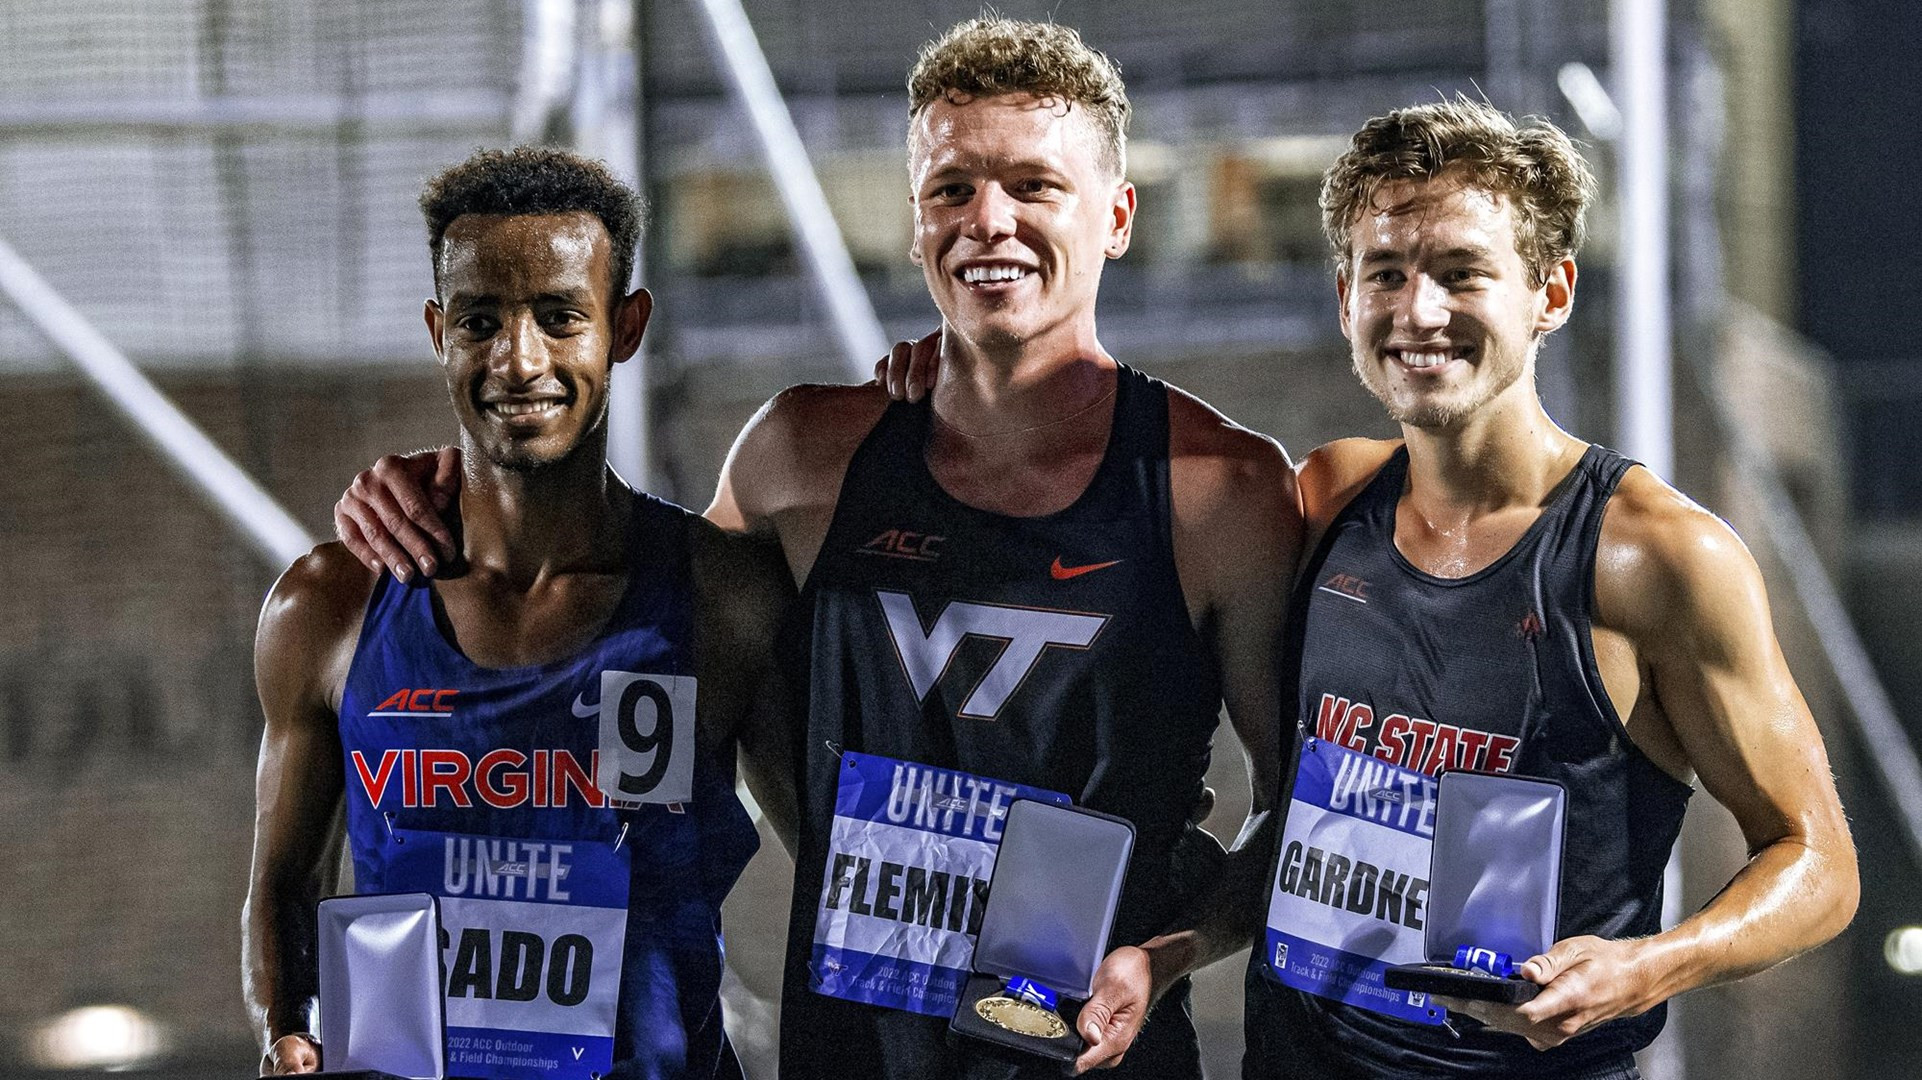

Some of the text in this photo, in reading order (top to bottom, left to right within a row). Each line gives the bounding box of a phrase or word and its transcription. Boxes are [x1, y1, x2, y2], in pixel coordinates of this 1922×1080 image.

[862, 528, 948, 558] ACC
[1322, 573, 1373, 599] ACC
[872, 587, 1113, 721] VT
[374, 687, 460, 712] ACC
[617, 679, 674, 796] 9
[1315, 693, 1521, 777] NC STATE
[350, 748, 686, 815] VIRGIN
[887, 764, 1018, 841] UNITE
[1329, 752, 1439, 836] UNITE
[444, 836, 573, 901] UNITE
[497, 862, 527, 875] ACC
[1278, 840, 1430, 931] GARDNE
[442, 927, 594, 1007] ADO
[447, 1036, 471, 1050] 2022
[495, 1038, 534, 1053] Outdoor
[449, 1051, 560, 1071] & Field Championships
